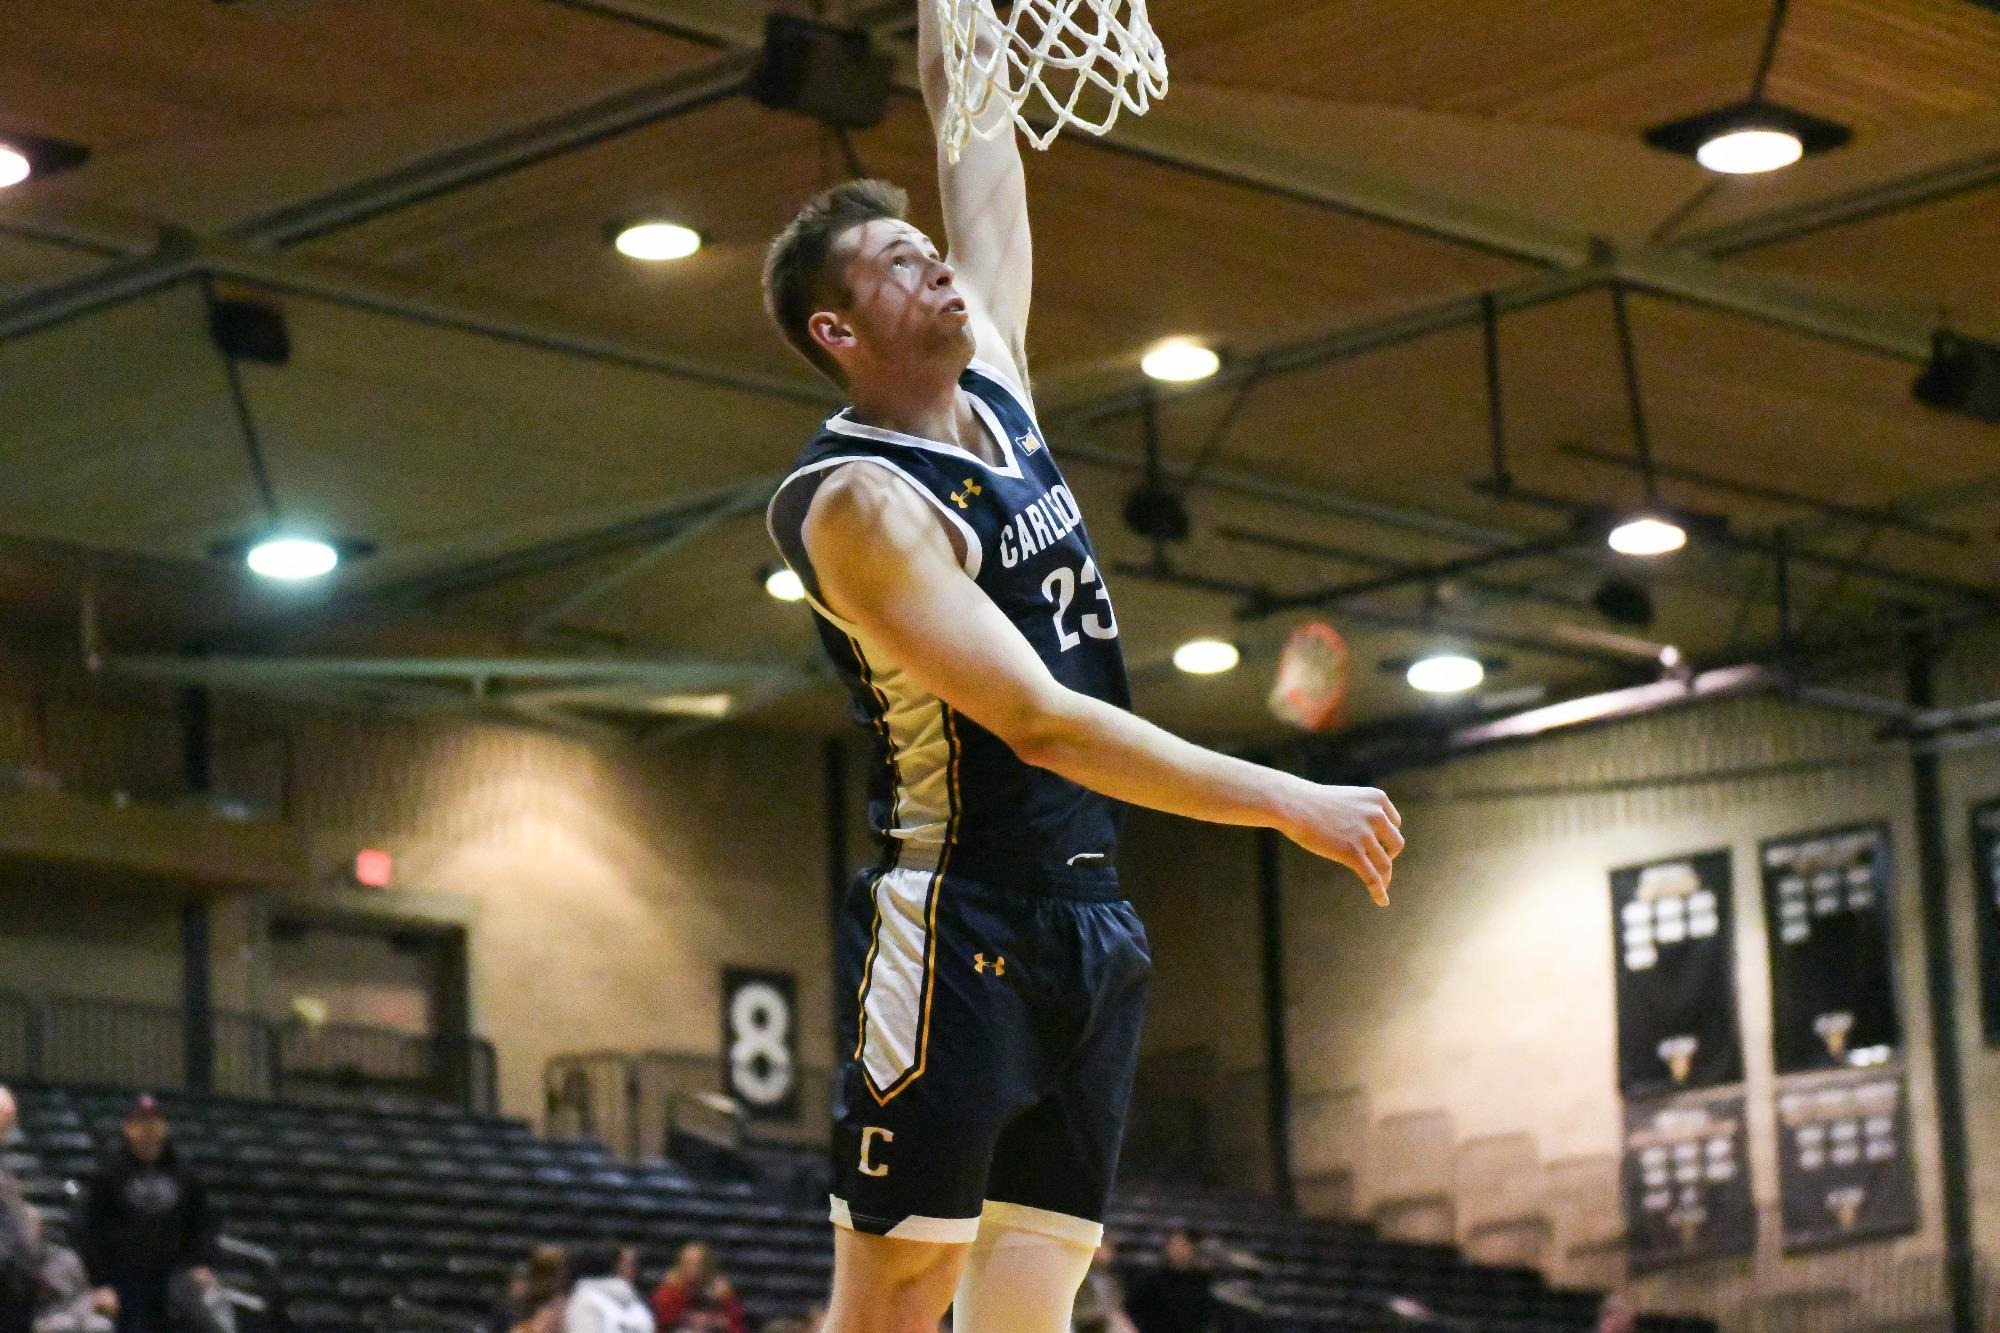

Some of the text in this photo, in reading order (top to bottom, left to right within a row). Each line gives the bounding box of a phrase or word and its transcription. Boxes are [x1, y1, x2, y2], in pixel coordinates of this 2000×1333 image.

[1041, 555, 1118, 652] 23
[731, 982, 792, 1103] 8
[858, 1126, 894, 1177] C
